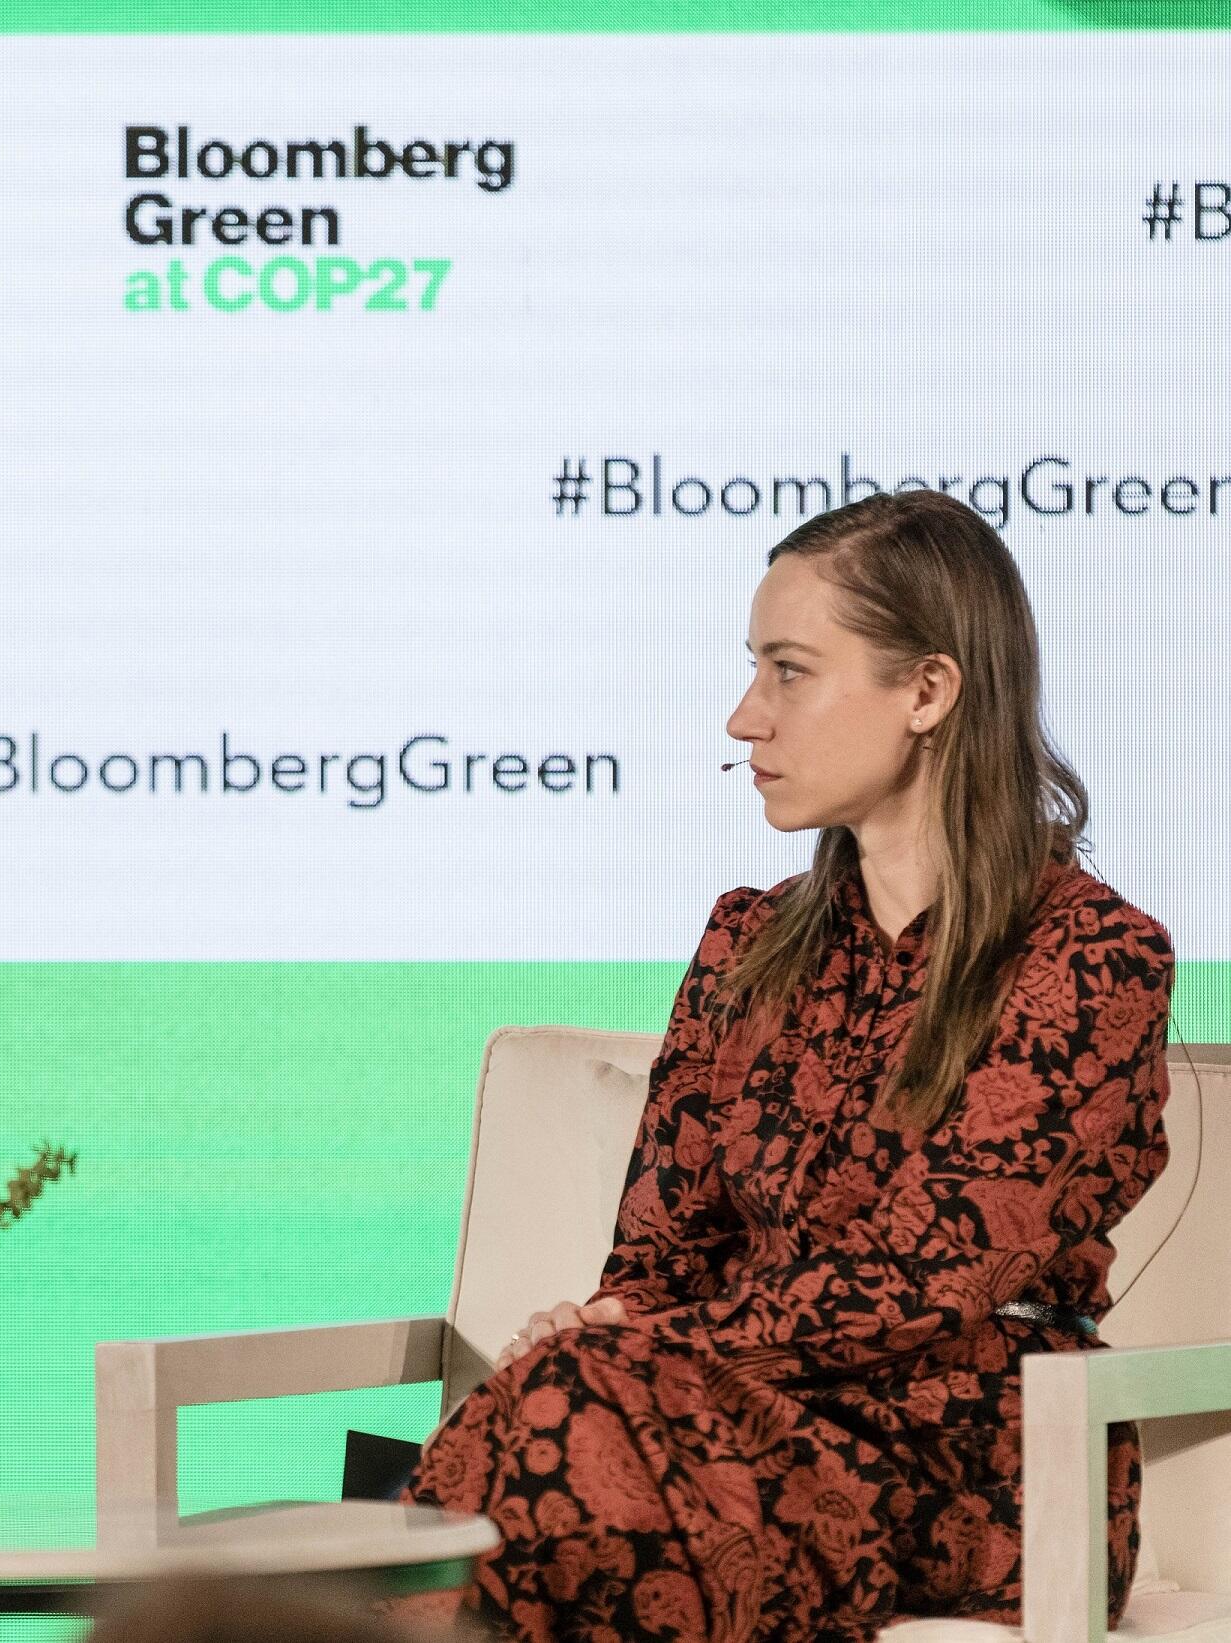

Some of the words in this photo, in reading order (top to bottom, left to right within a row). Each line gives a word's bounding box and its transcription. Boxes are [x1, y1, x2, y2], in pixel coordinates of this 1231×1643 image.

[125, 124, 516, 192] Bloomberg
[124, 193, 340, 246] Green
[123, 259, 189, 311] at
[202, 255, 453, 312] COP27
[552, 453, 1231, 529] #BloombrgGreen
